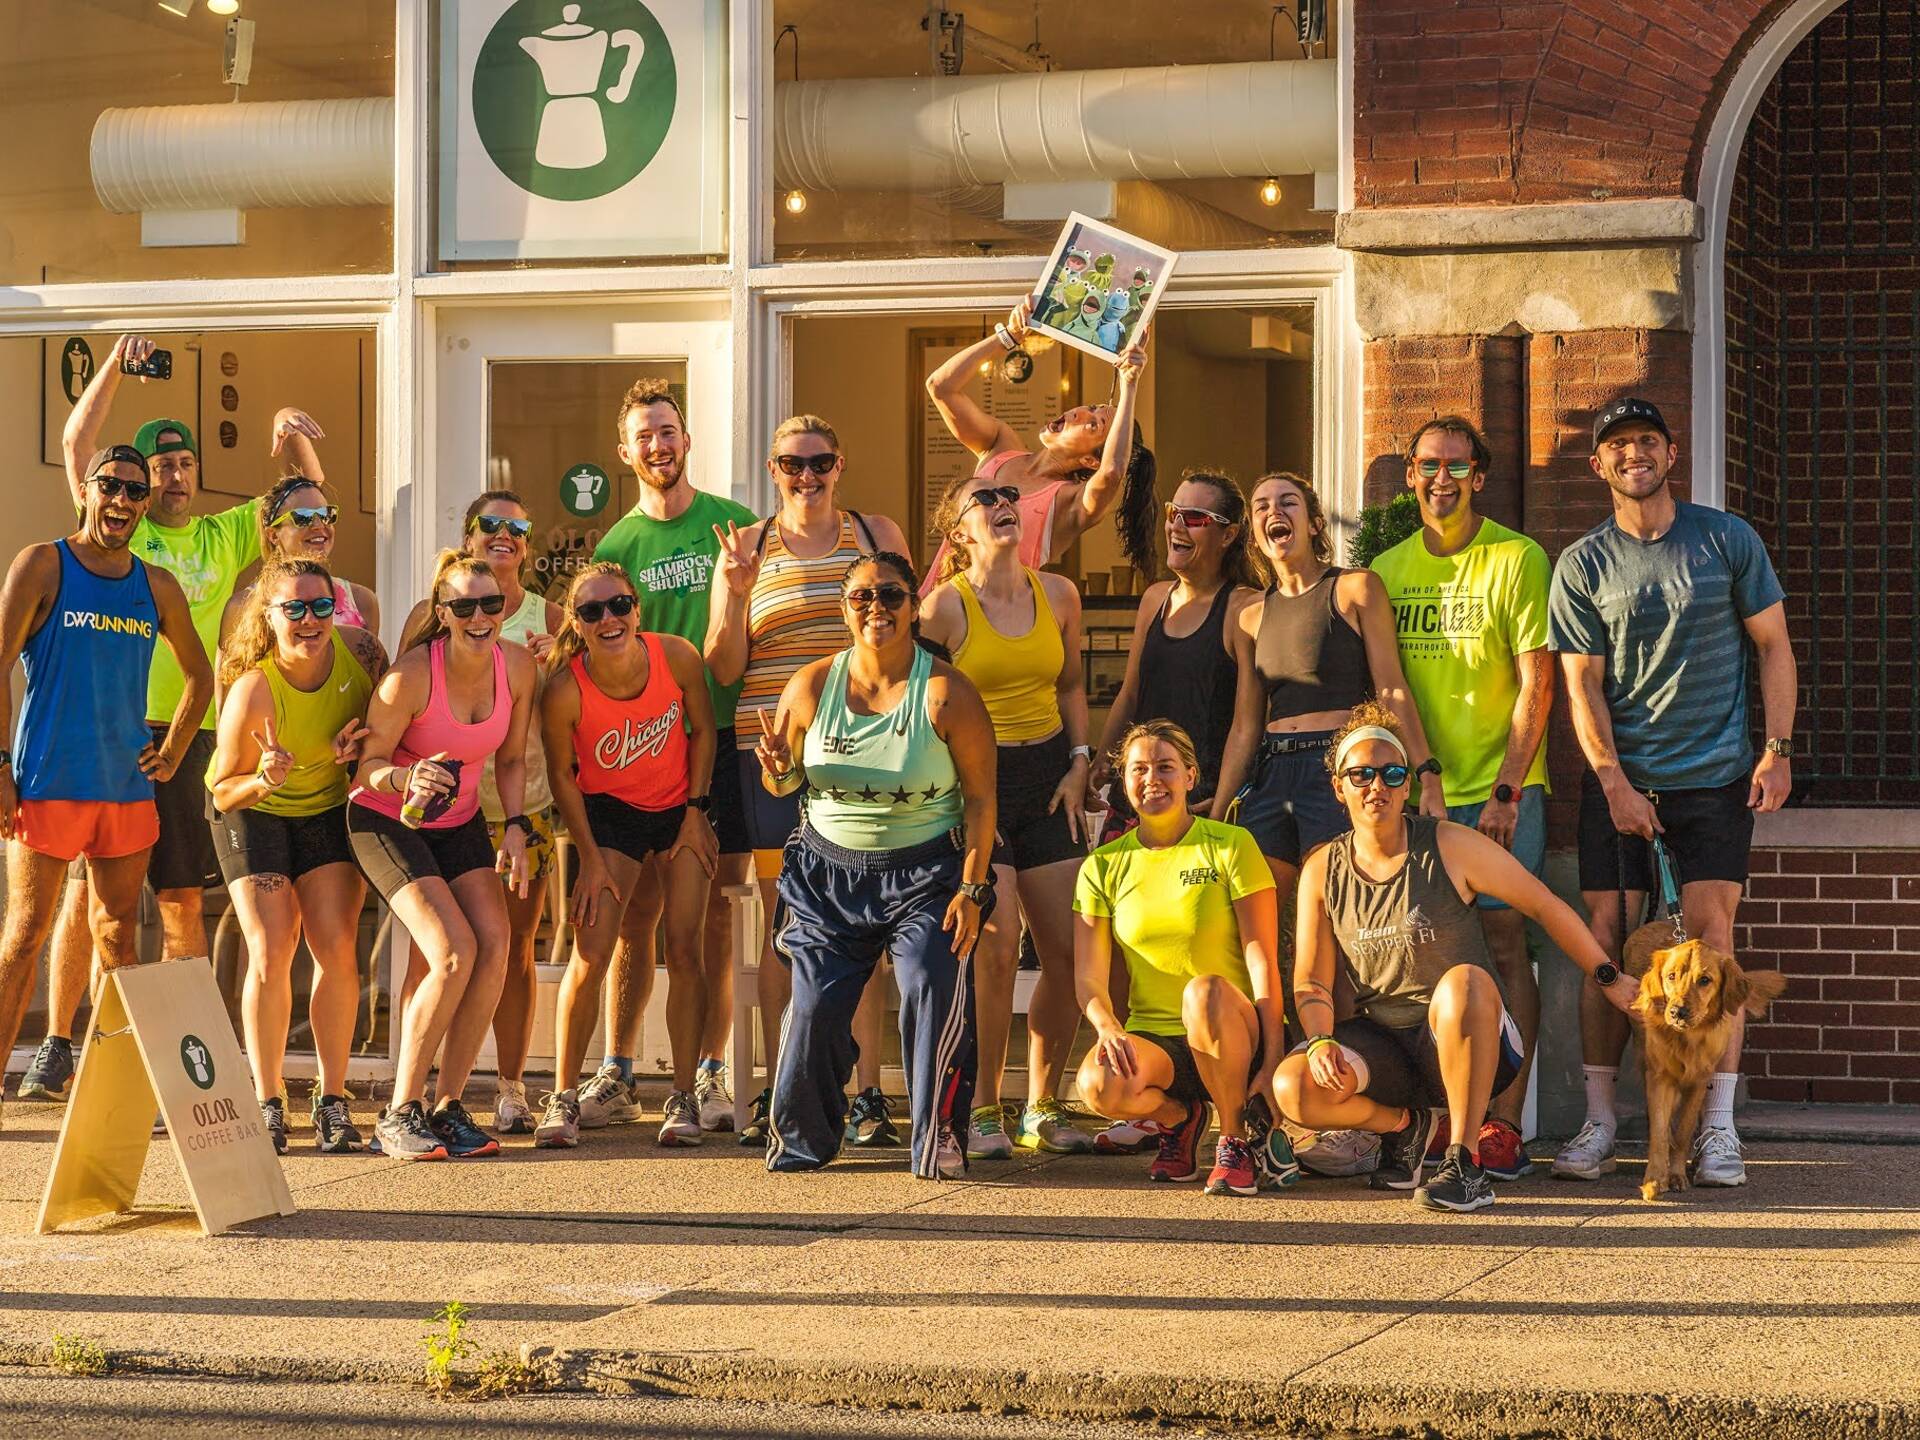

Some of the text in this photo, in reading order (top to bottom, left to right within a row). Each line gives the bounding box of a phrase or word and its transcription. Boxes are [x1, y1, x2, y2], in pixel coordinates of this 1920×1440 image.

[547, 526, 601, 552] OLO
[525, 556, 594, 574] OFFE
[640, 554, 714, 583] SHAMROCK
[648, 567, 708, 592] SHUFFLE
[690, 585, 706, 593] 2020
[1424, 586, 1434, 594] OF
[64, 611, 152, 639] DWRUNNING
[594, 700, 680, 771] Chicago
[1298, 740, 1332, 749] SPIB
[1180, 868, 1210, 879] FLEET
[1183, 876, 1209, 887] FEET
[1351, 928, 1437, 955] SEMPER FI
[1357, 926, 1397, 940] Team
[192, 1098, 240, 1128] OLOR
[187, 1122, 260, 1151] COFFEE BAR
